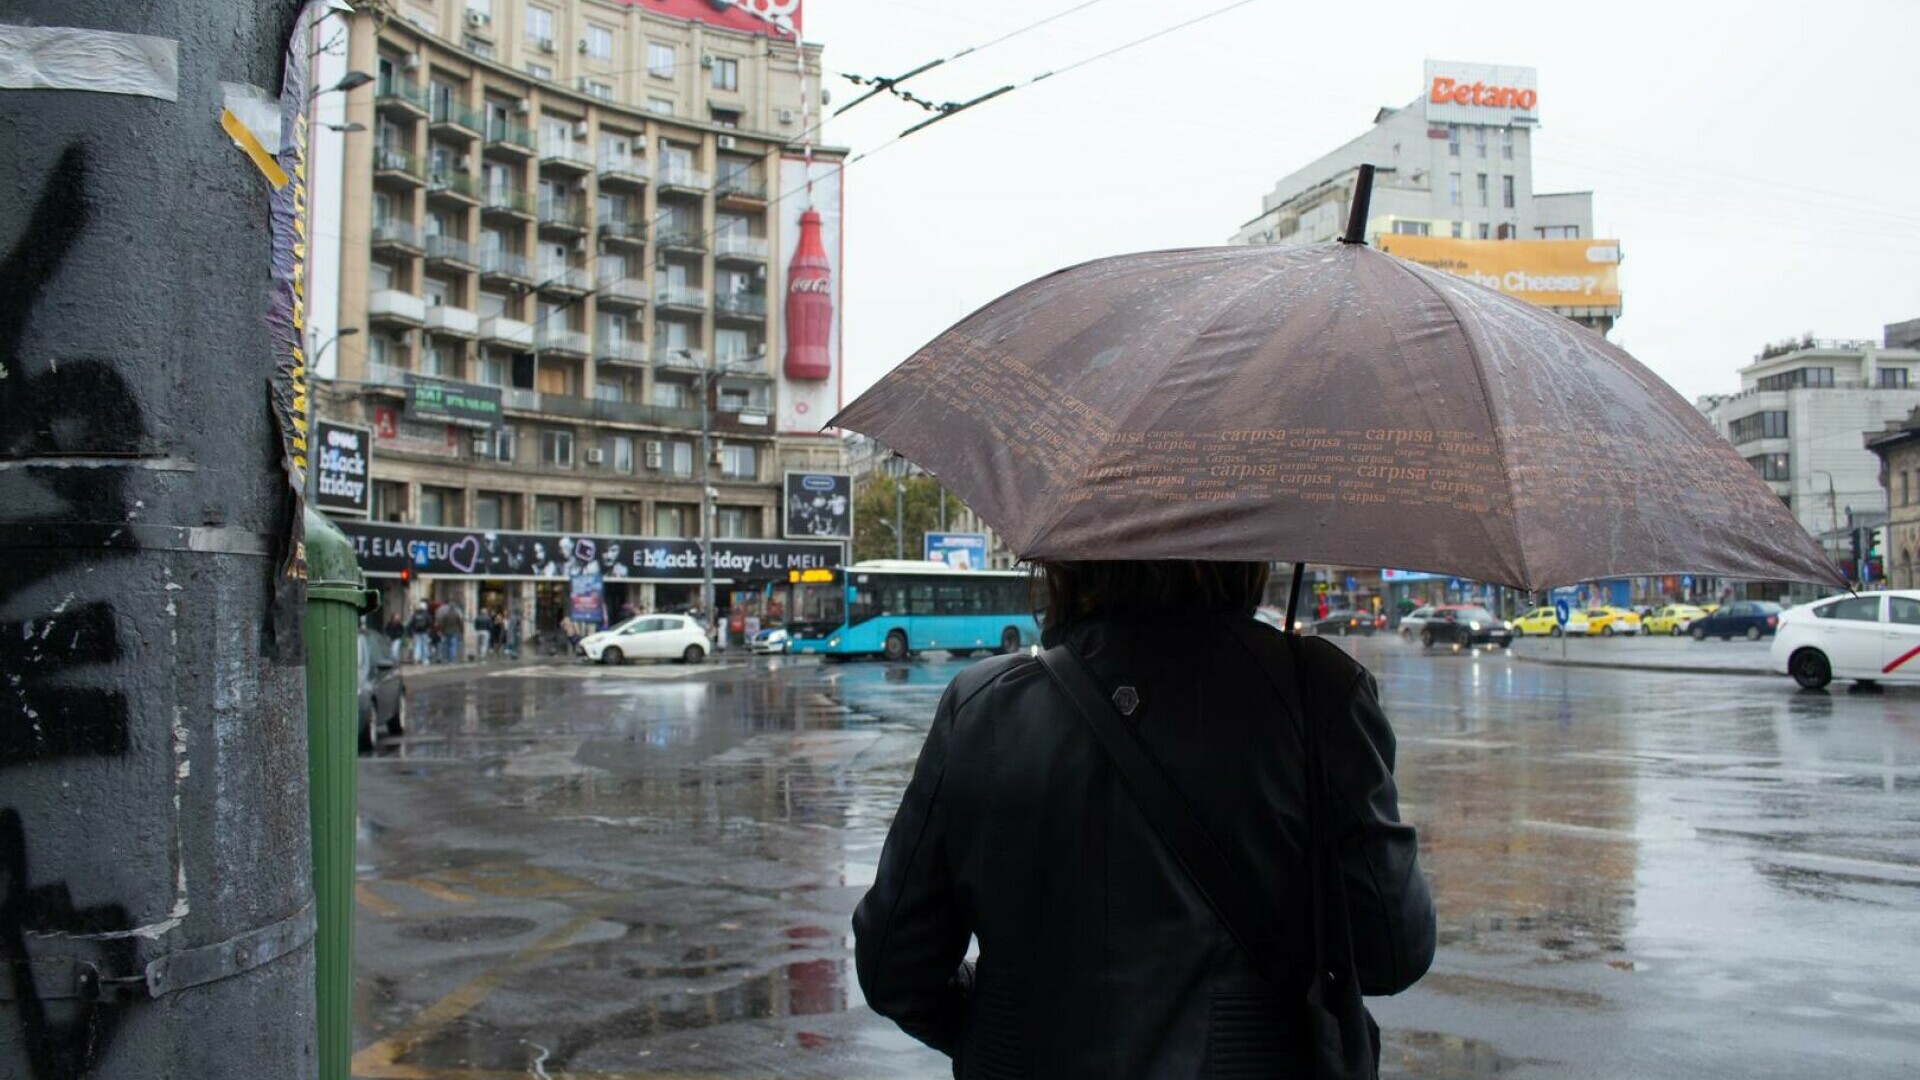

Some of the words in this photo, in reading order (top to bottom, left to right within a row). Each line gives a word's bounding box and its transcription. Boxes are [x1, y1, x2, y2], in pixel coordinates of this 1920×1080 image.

[1430, 76, 1537, 111] Betano
[1147, 440, 1197, 452] carpisa
[1290, 438, 1341, 450] carpisa
[1221, 430, 1286, 445] carpisa
[1365, 429, 1433, 446] carpisa
[1351, 454, 1394, 466] carpisa
[1136, 475, 1186, 487] carpisa
[1280, 473, 1332, 487] carpisa
[1210, 462, 1277, 480] carpisa
[1357, 464, 1427, 484] carpisa
[319, 470, 364, 503] friday
[372, 536, 382, 556] E
[385, 538, 404, 558] LA
[407, 539, 449, 561] CEU
[633, 550, 643, 567] E
[644, 547, 697, 570] black
